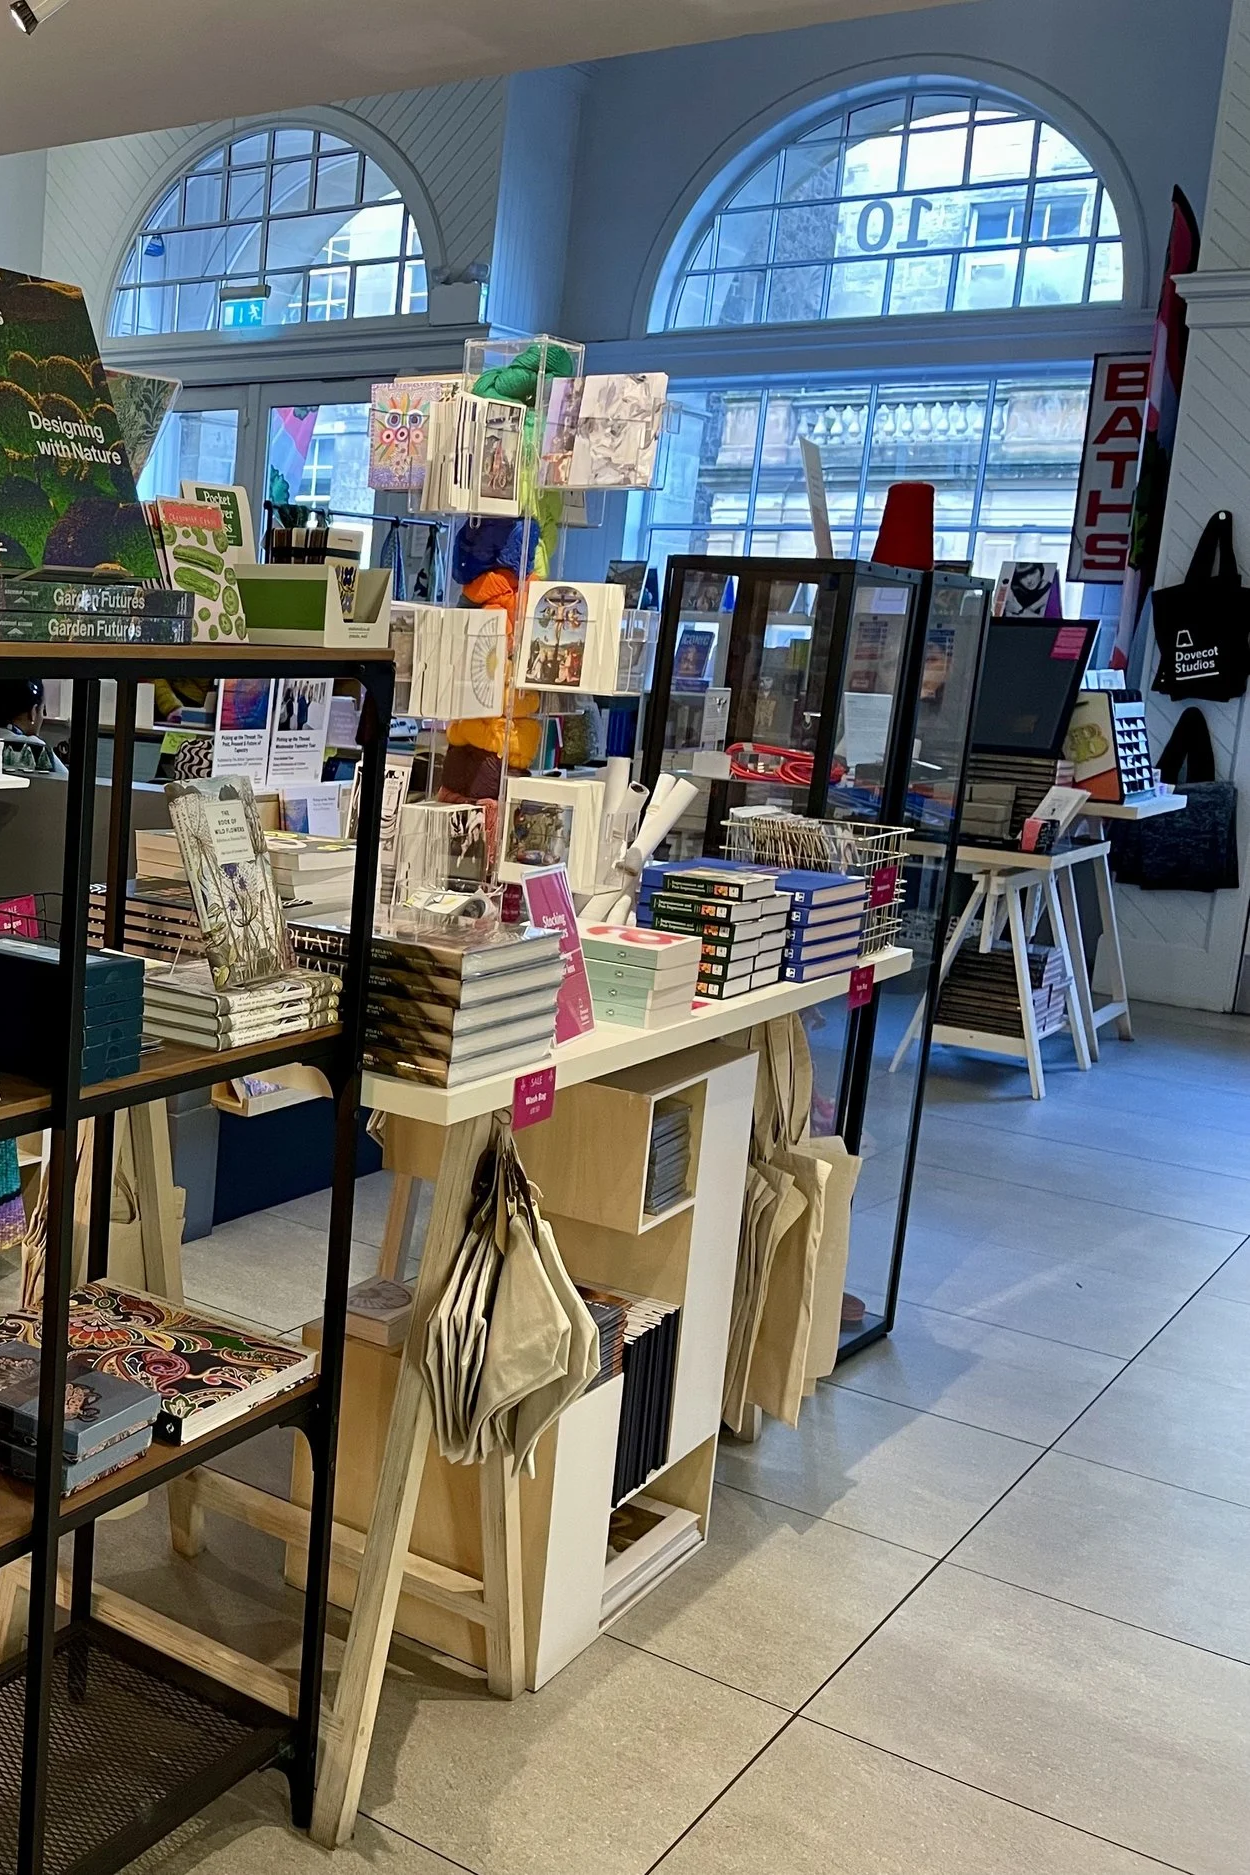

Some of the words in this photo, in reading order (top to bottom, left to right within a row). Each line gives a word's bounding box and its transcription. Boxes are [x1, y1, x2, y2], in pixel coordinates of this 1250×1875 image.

[28, 411, 104, 444] Designing
[36, 438, 72, 458] with
[70, 442, 122, 465] Nature
[1082, 362, 1150, 570] BATHS
[203, 491, 230, 505] Pocket
[53, 588, 99, 612] Garden
[101, 592, 145, 610] Futures
[48, 618, 95, 636] Garden
[97, 620, 142, 637] Futures
[1176, 646, 1218, 662] Dovecot
[1175, 660, 1215, 673] Studios
[542, 912, 566, 928] Stocking
[531, 1075, 543, 1087] SALE
